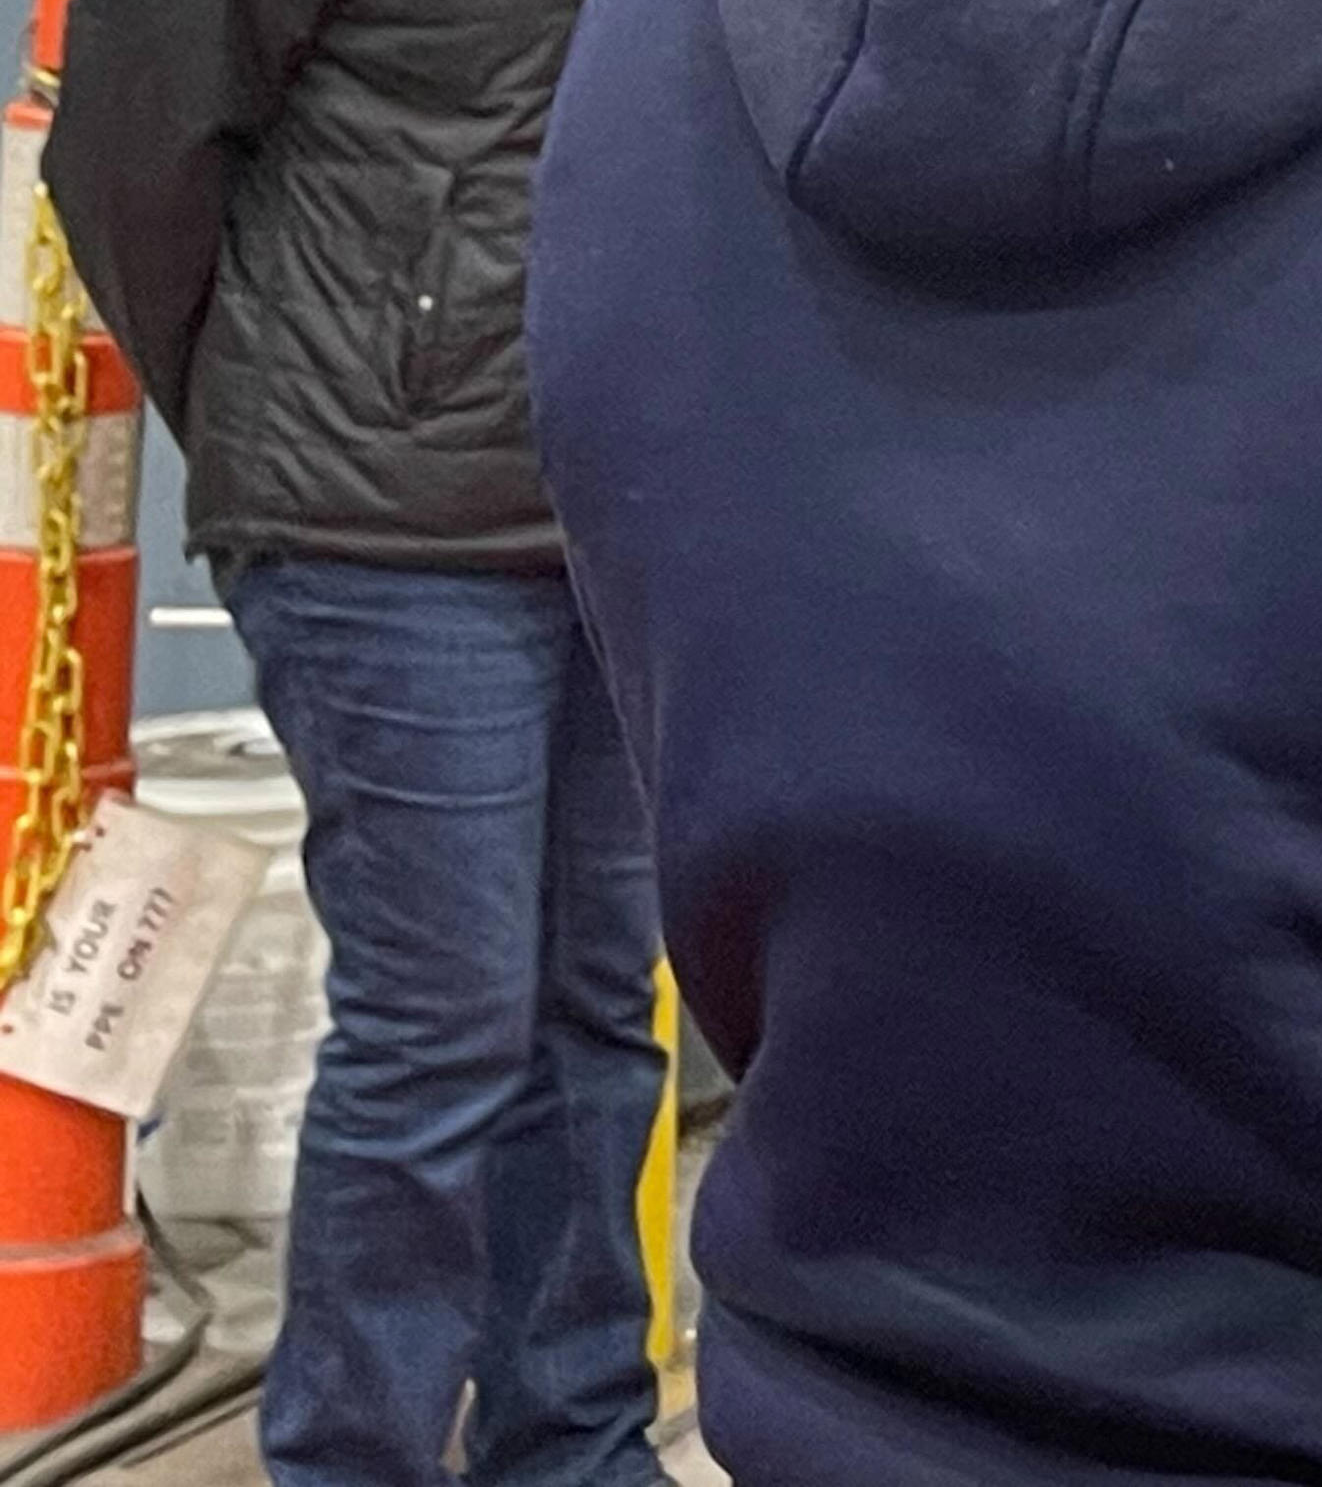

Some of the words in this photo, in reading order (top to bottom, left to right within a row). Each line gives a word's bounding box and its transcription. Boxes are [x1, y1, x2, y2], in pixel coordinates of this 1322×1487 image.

[48, 989, 76, 1015] IS
[66, 900, 117, 974] YOUR
[85, 1003, 125, 1051] PPE
